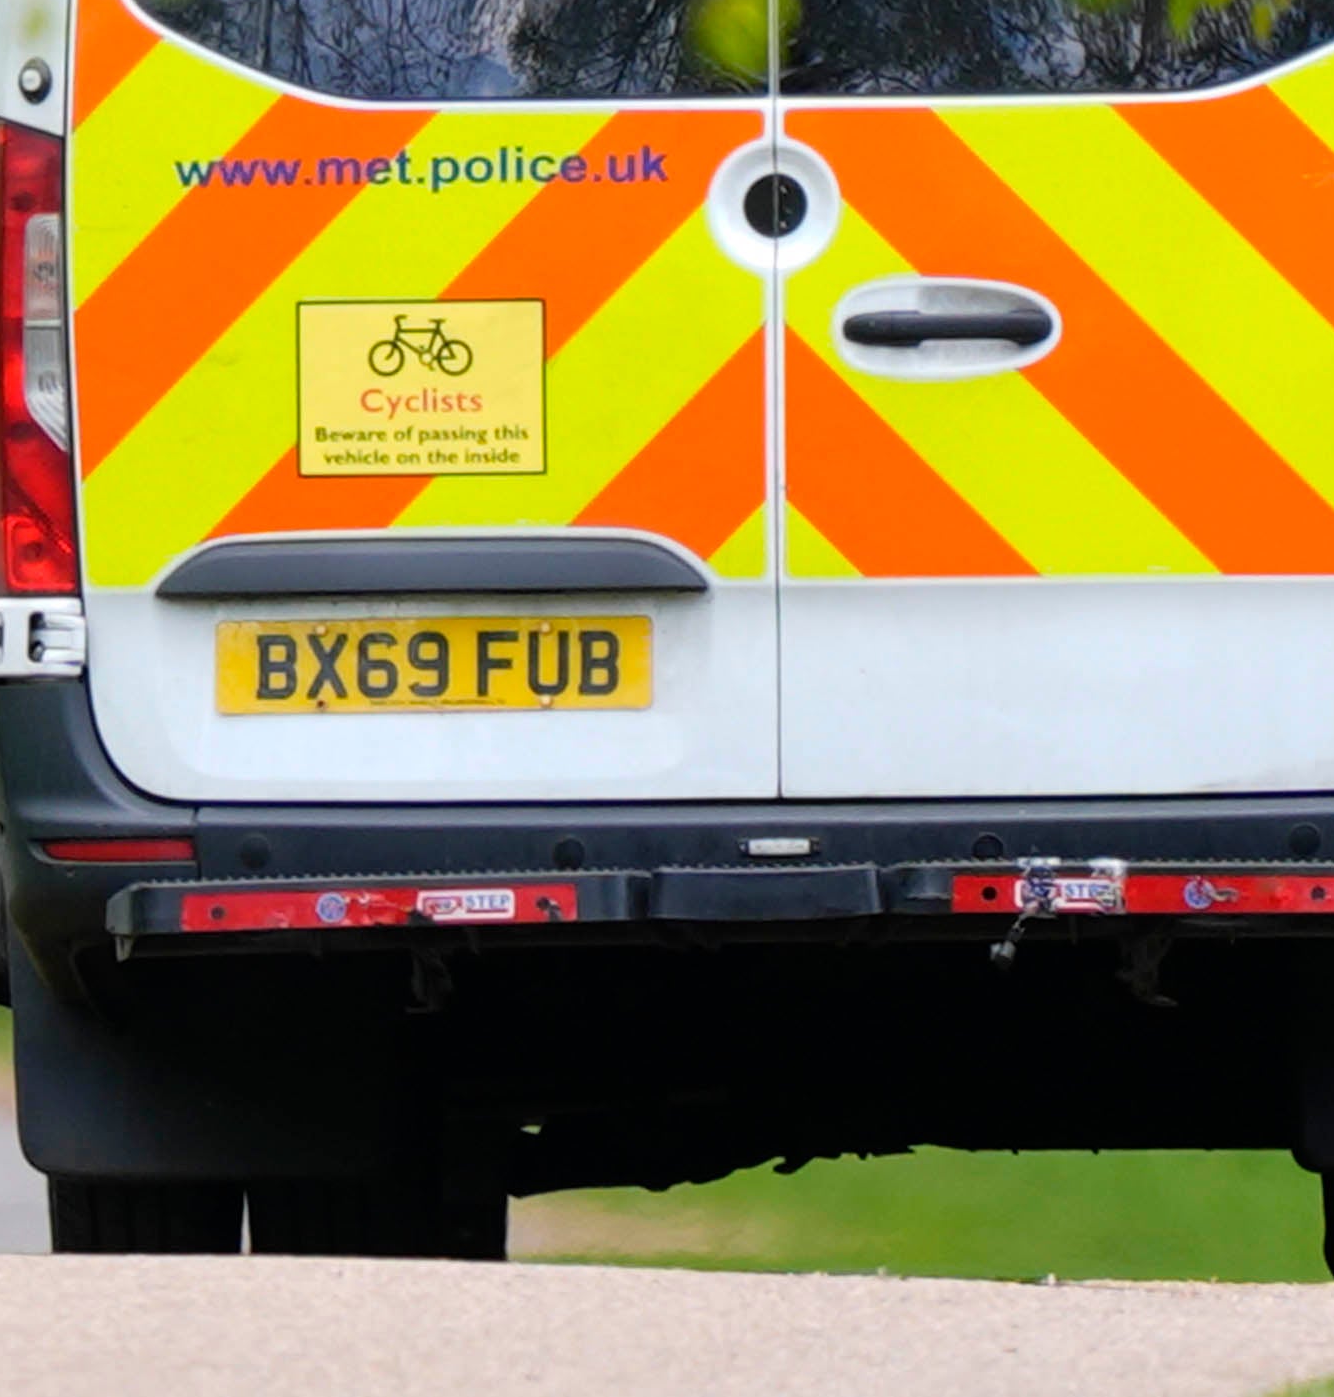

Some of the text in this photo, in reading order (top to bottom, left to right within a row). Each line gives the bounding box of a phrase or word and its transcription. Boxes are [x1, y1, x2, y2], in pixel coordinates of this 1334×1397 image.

[175, 145, 668, 193] www.met.police.uk
[359, 388, 483, 420] Cyclists
[315, 424, 530, 445] Beware of passing this
[322, 448, 521, 465] vehicle on the inside
[255, 630, 620, 701] BX69 FUB
